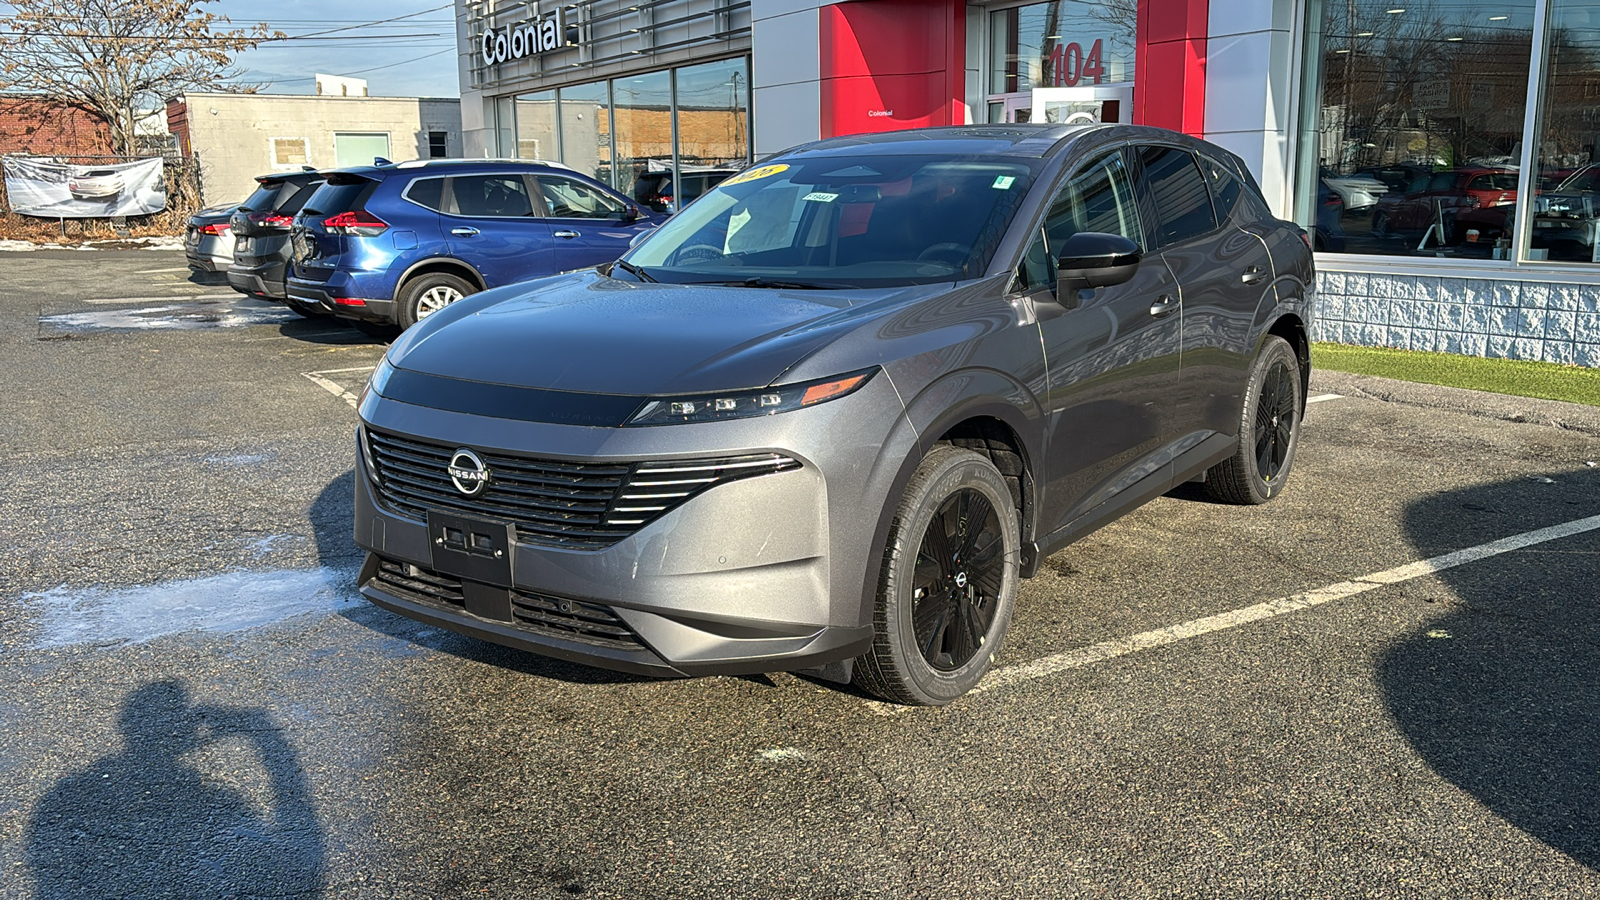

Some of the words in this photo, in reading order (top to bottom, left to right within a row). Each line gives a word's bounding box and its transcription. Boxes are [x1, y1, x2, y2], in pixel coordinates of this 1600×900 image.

[482, 7, 562, 65] Colonial
[1049, 39, 1104, 87] 104
[1419, 82, 1440, 90] PARTS
[868, 109, 893, 117] Colonial
[447, 466, 488, 481] NISSAN
